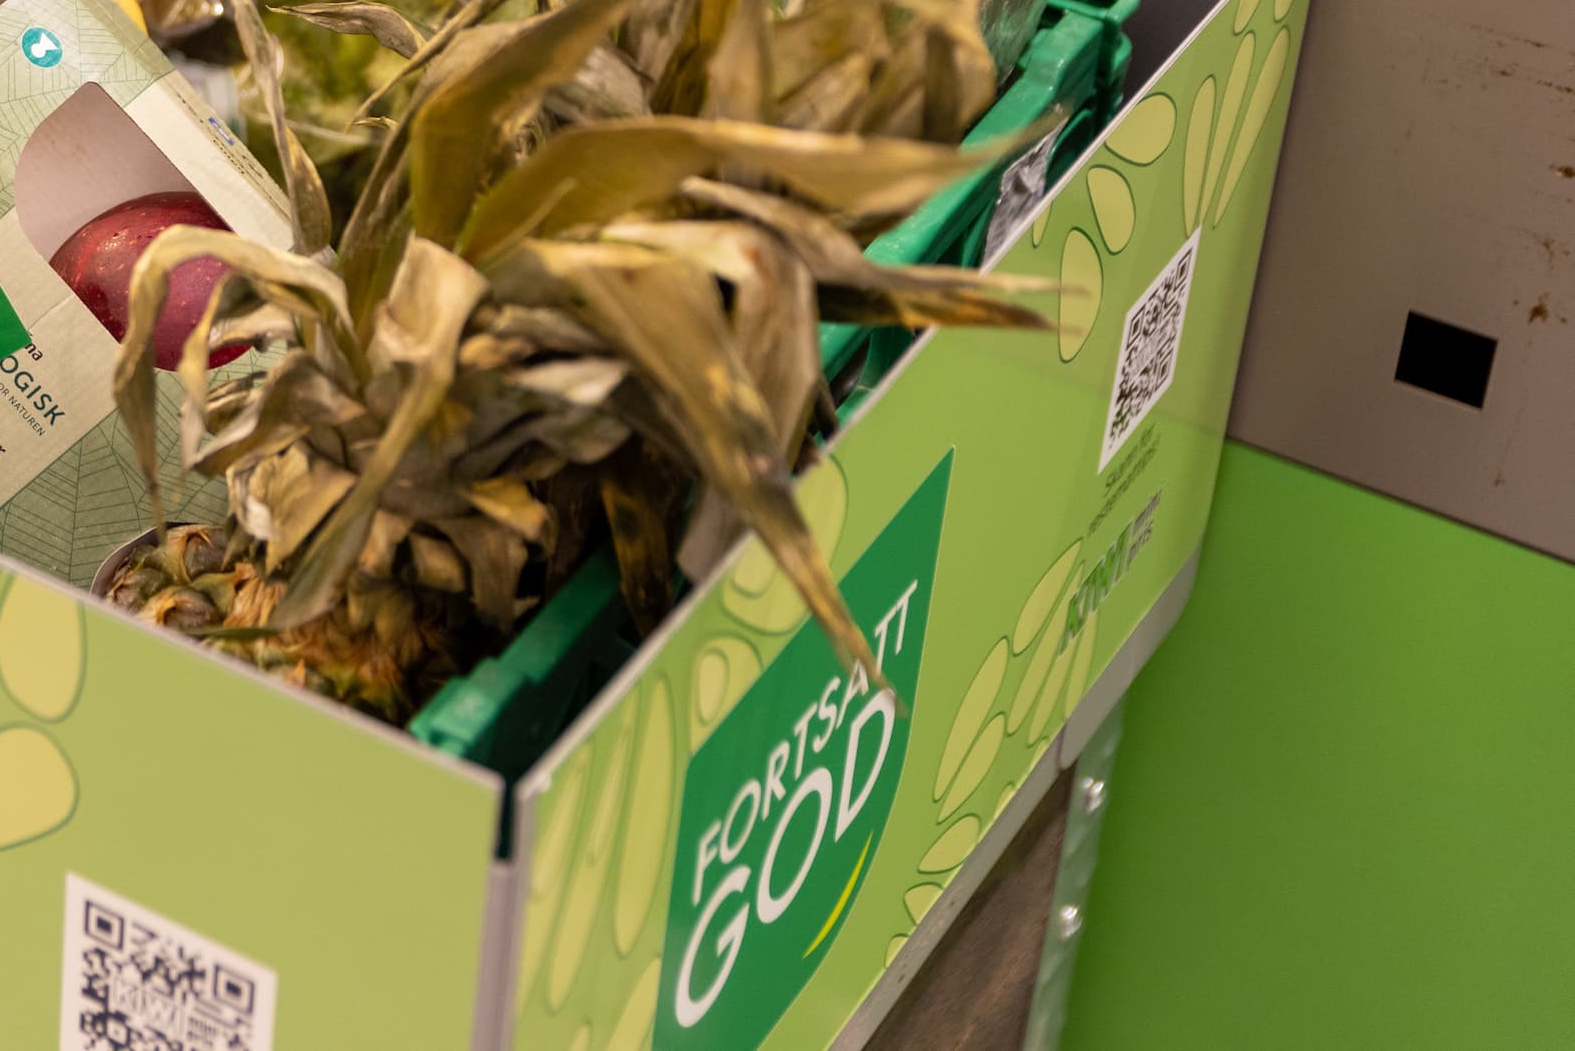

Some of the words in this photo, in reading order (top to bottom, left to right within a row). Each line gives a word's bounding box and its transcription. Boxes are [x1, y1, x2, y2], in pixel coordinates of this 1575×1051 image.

[9, 395, 47, 437] NATUREN
[673, 689, 896, 1028] GOD
[692, 579, 919, 907] FORTSATT
